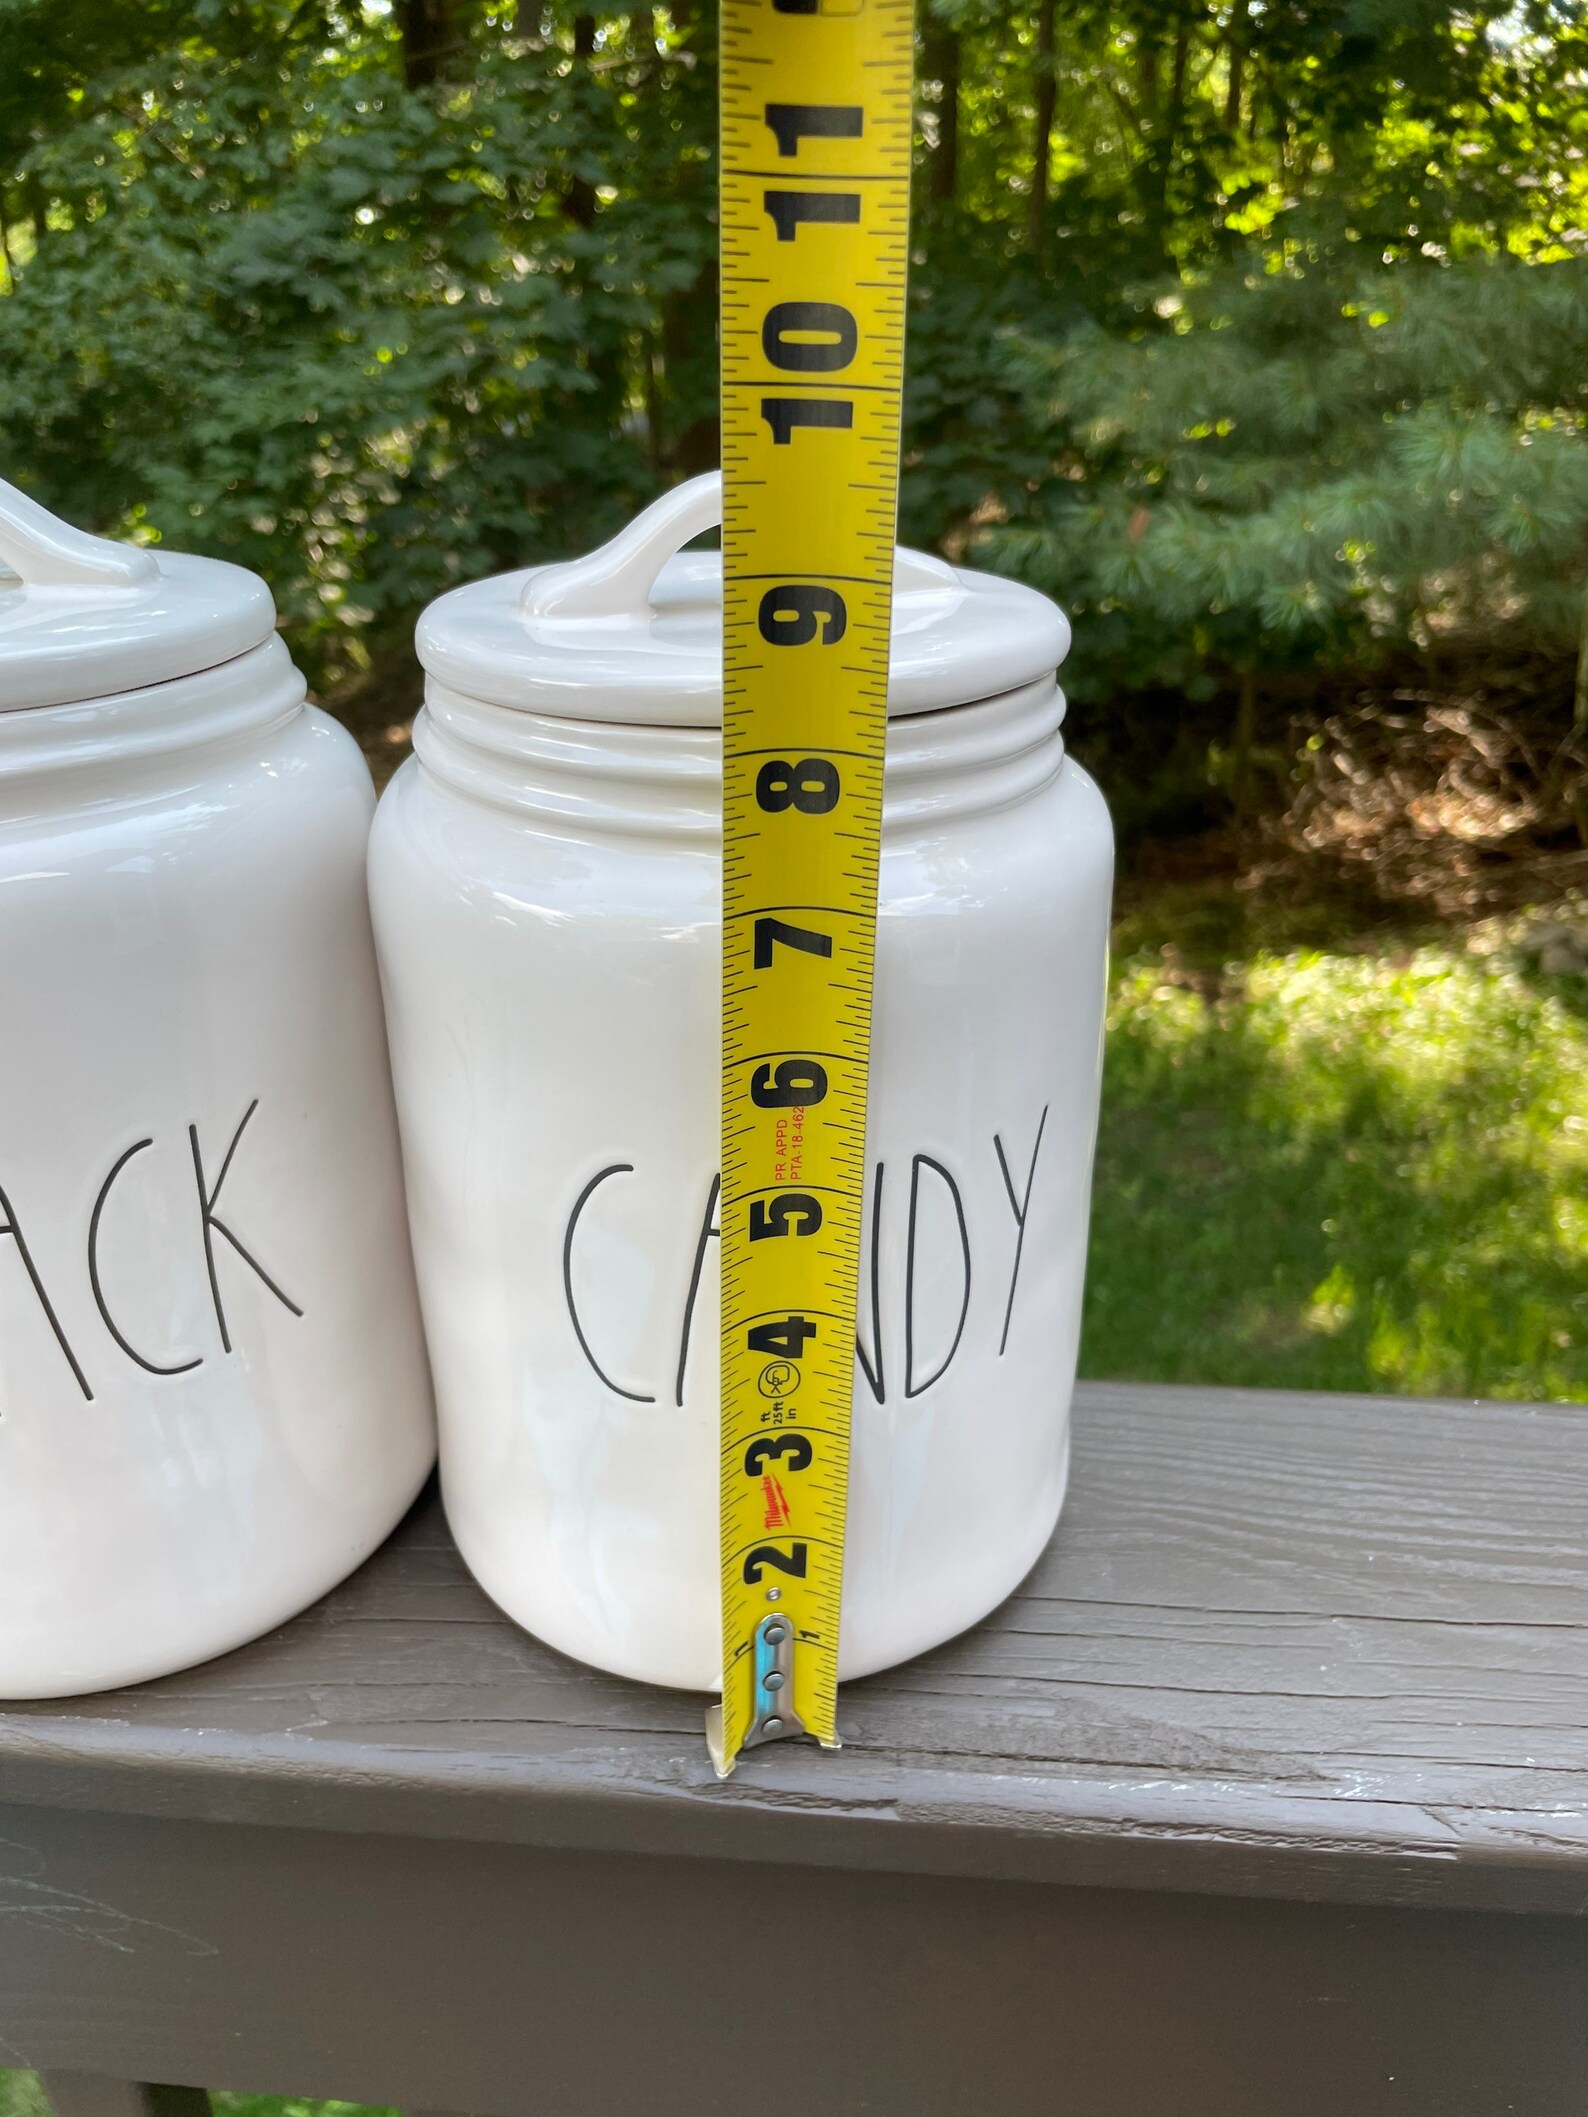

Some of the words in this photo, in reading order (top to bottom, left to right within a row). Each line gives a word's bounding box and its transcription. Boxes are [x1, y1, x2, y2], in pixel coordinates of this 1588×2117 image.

[764, 103, 865, 243] 11
[761, 301, 857, 446] 10
[758, 584, 848, 647] 9
[755, 758, 841, 815] 8
[753, 917, 833, 970] 7
[750, 1059, 829, 1110] 6
[775, 1119, 788, 1157] APPD
[775, 1162, 787, 1181] PR
[749, 1193, 823, 1243] 5
[747, 1316, 817, 1359] 4
[744, 1433, 813, 1477] 3
[743, 1543, 808, 1585] 2
